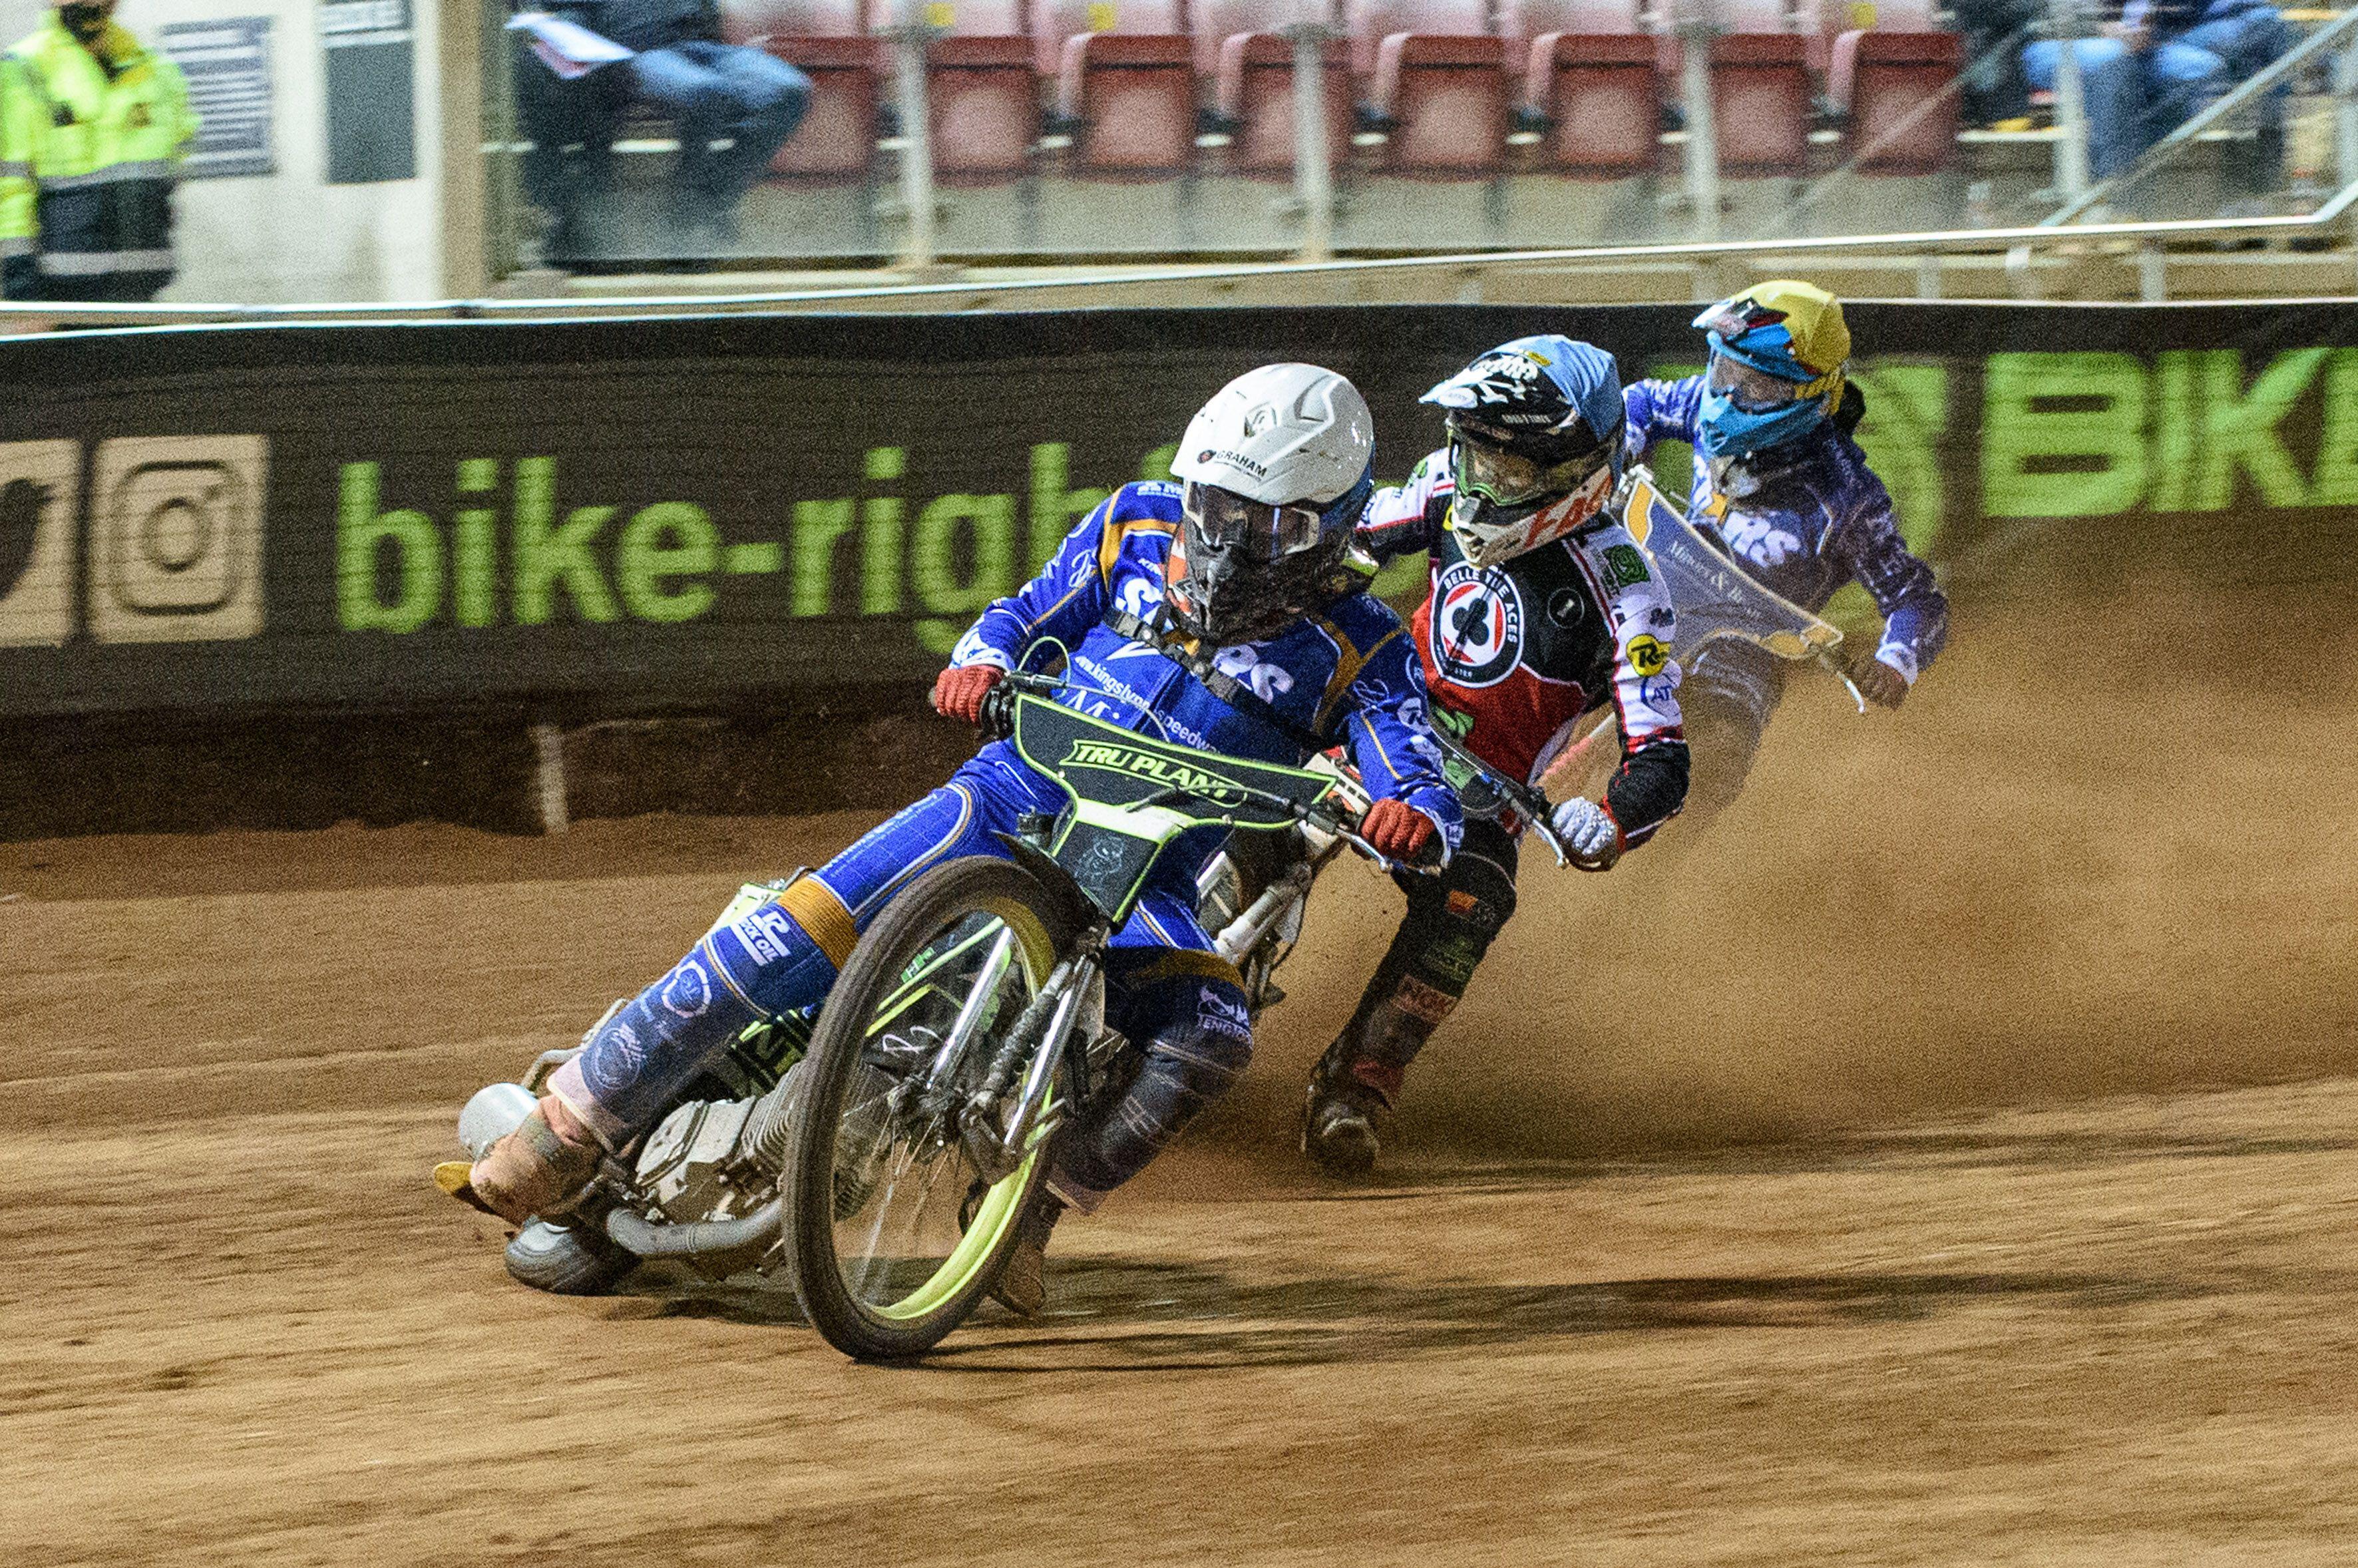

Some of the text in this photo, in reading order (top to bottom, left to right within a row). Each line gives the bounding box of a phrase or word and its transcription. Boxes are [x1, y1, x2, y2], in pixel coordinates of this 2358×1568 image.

[1983, 346, 2358, 518] BIK
[1217, 451, 1267, 477] GRAHAM
[1444, 568, 1481, 590] BELLE
[1505, 603, 1518, 643] ACES
[1075, 745, 1229, 799] TRU PLANT
[755, 938, 780, 962] OIL
